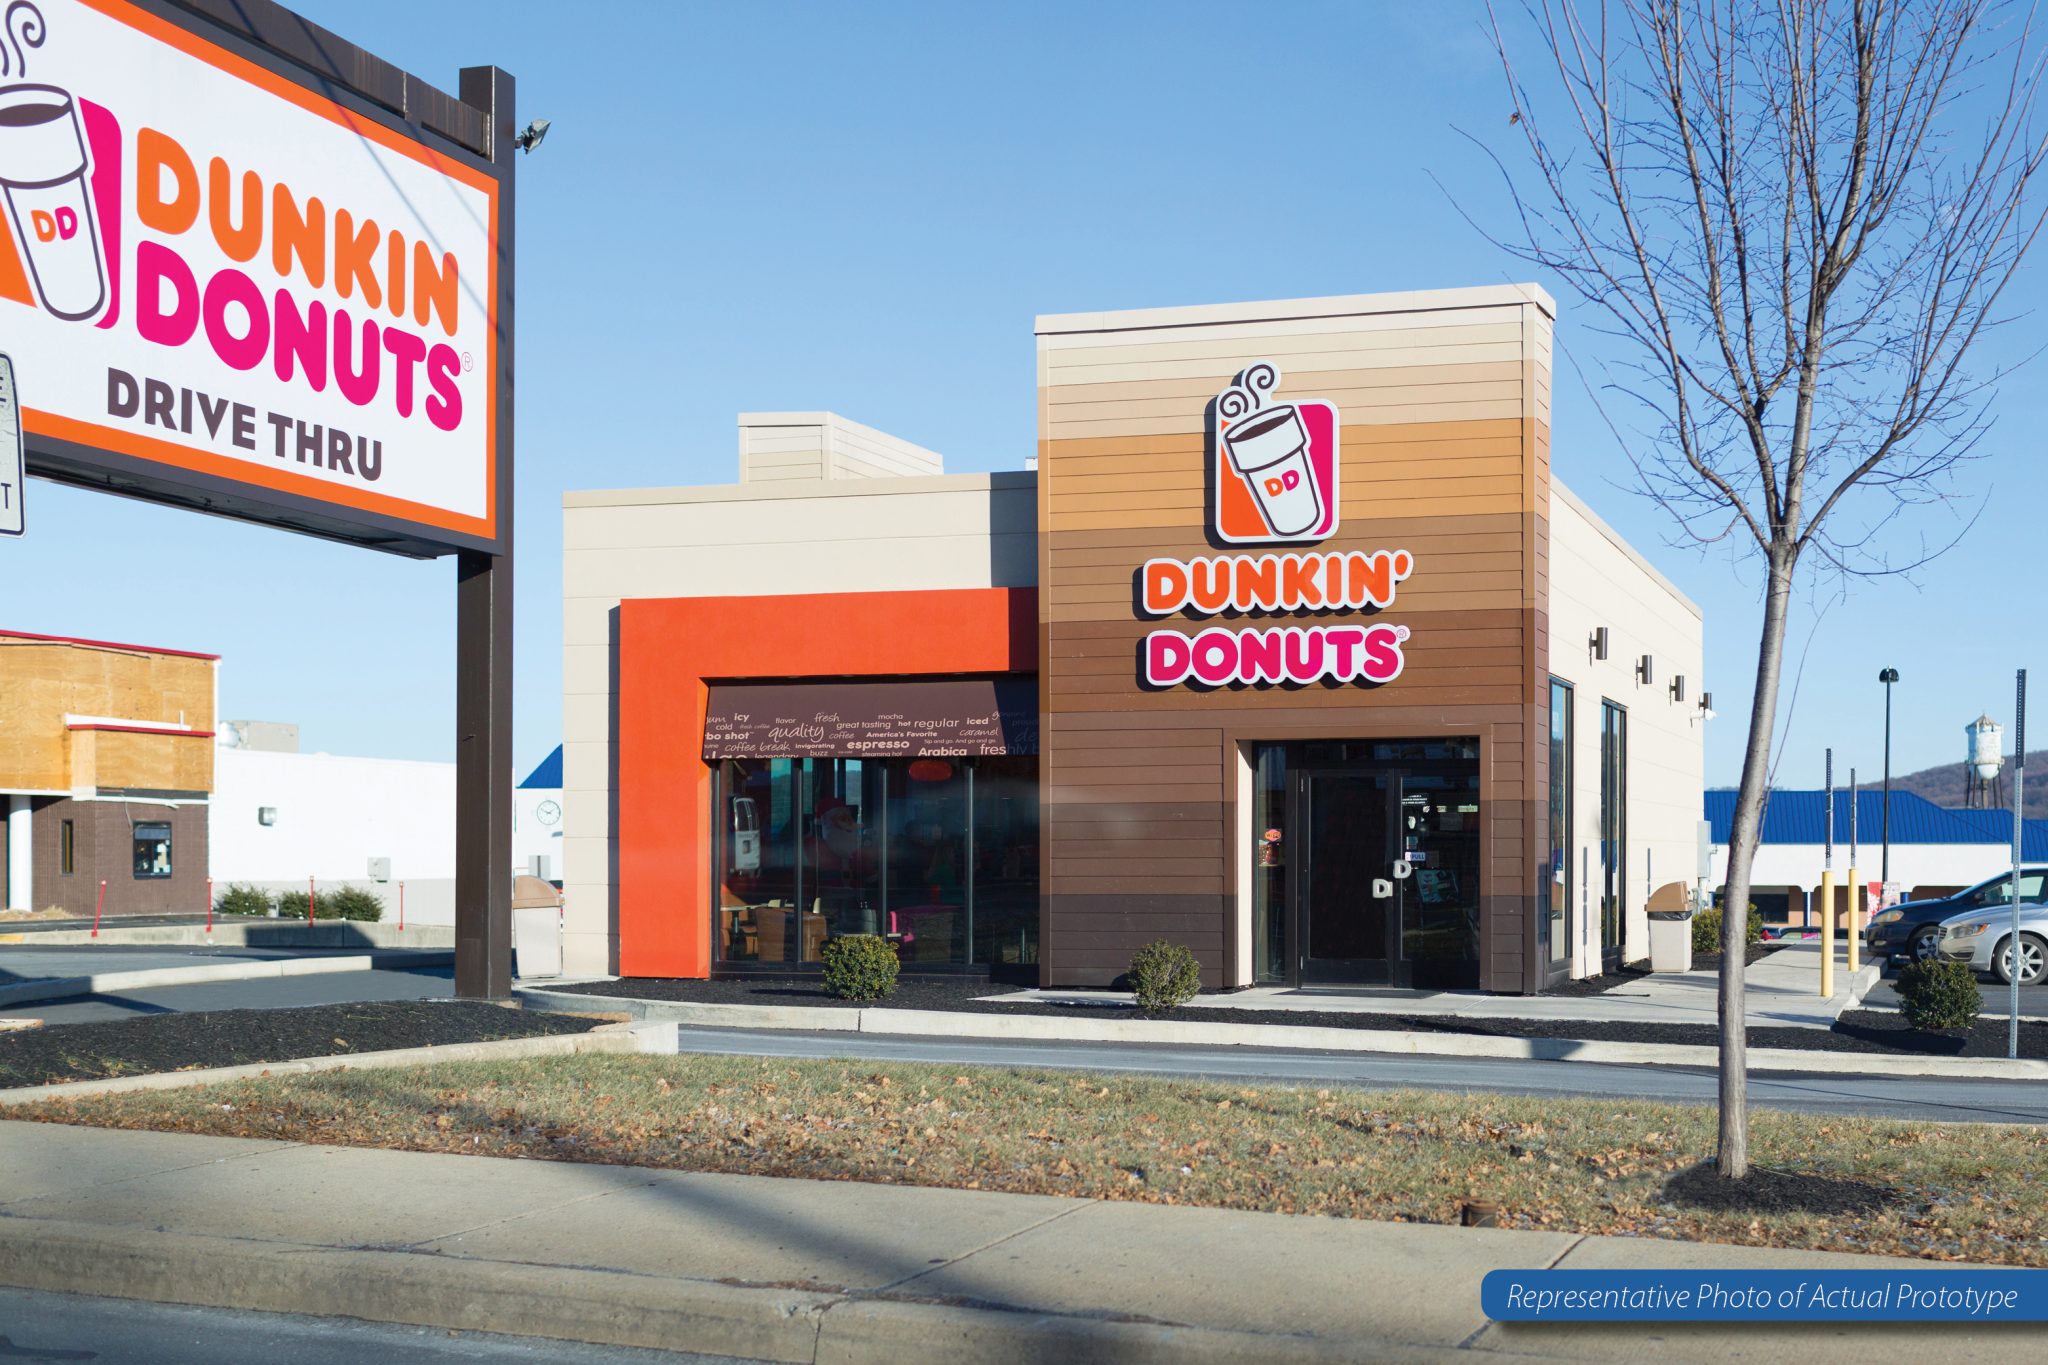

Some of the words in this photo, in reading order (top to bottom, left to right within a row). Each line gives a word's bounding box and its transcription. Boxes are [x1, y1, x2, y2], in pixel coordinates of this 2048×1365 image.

[31, 206, 78, 242] DD
[137, 127, 459, 337] DUNKIN
[137, 240, 463, 432] DONUTS
[107, 367, 256, 450] DRIVE
[268, 411, 383, 482] THRU
[1264, 469, 1300, 498] DD
[1147, 553, 1409, 610] DUNKIN'
[1150, 629, 1400, 682] DONUTS
[734, 712, 750, 722] icy
[813, 712, 840, 723] fresh
[966, 716, 989, 725] iced
[716, 723, 733, 731] cold
[836, 720, 860, 731] great
[861, 720, 892, 731] tasting
[898, 719, 912, 727] hot
[914, 718, 960, 731] regular
[768, 722, 825, 743] quality
[828, 731, 856, 740] coffee
[959, 727, 999, 737] caramel
[724, 741, 757, 752] coffee
[759, 741, 791, 752] break
[846, 740, 910, 752] espresso
[918, 746, 967, 756] Arabica
